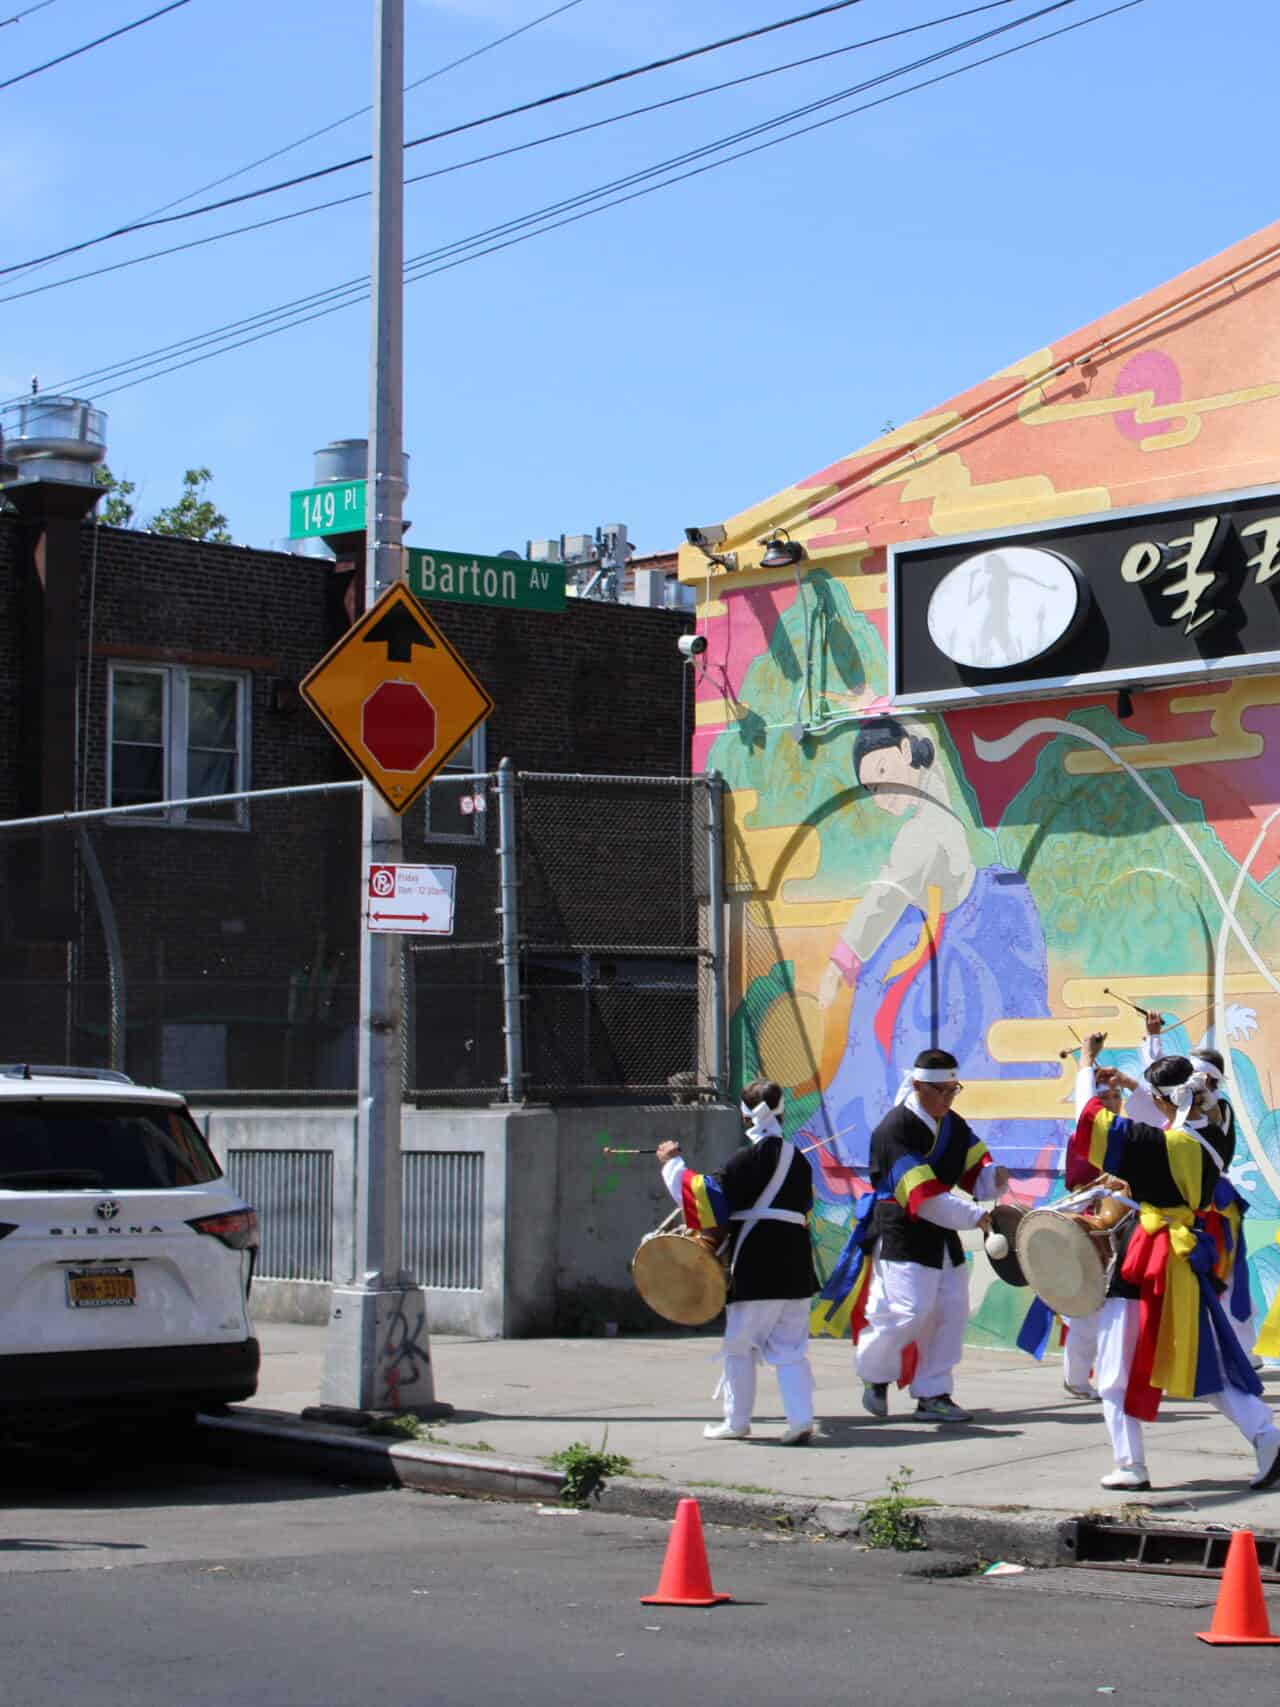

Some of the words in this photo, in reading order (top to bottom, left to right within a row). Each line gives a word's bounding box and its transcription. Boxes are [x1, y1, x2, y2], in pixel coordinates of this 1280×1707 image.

[301, 491, 335, 531] 149
[344, 487, 357, 511] Pl
[420, 554, 517, 600] Barton
[529, 567, 550, 591] Av
[50, 1224, 164, 1236] SIENNA
